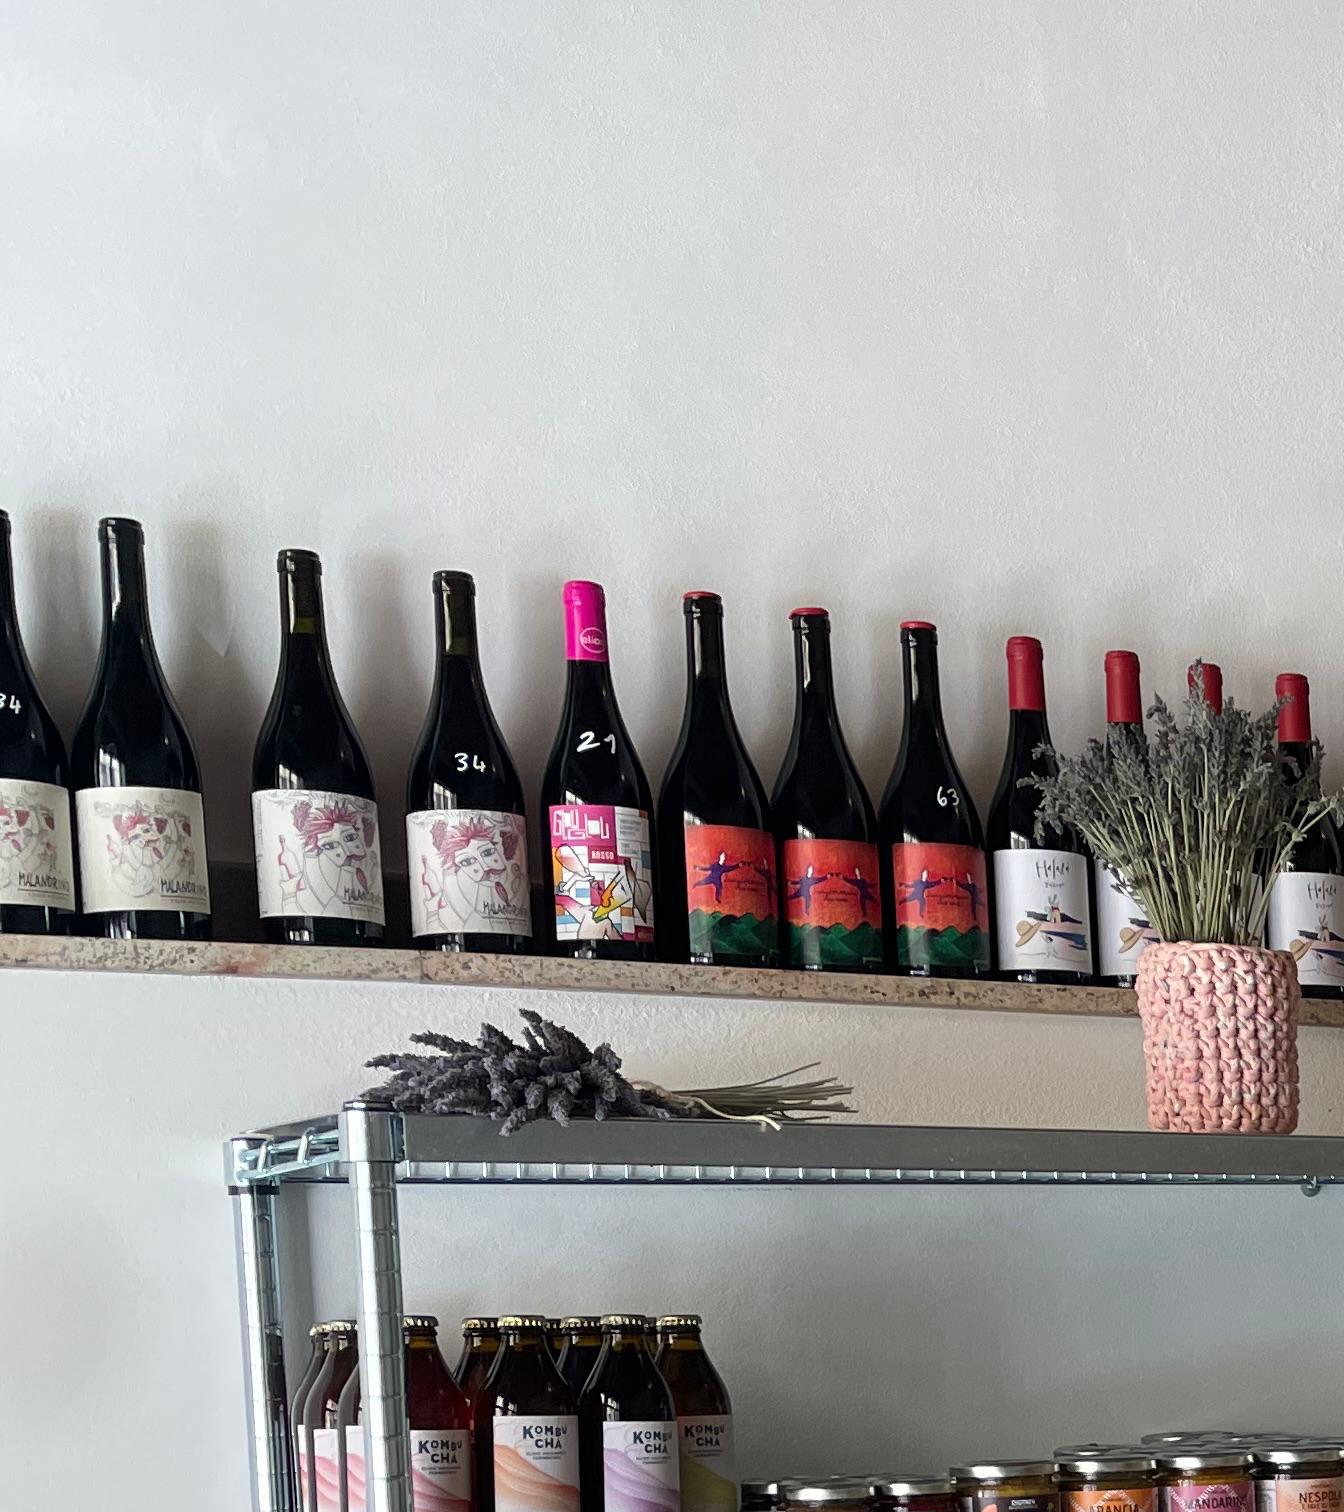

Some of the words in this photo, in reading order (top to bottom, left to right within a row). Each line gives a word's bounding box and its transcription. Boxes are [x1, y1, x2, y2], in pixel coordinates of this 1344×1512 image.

[576, 730, 616, 754] 21
[454, 752, 486, 772] 34
[937, 786, 959, 807] 63
[523, 1424, 568, 1440] KOMBU
[633, 1430, 672, 1446] KOMBU
[684, 1424, 726, 1439] KOMBU
[418, 1439, 463, 1455] KOMBU
[535, 1437, 562, 1450] CHA
[644, 1442, 668, 1455] CHA
[696, 1435, 720, 1448] CHA
[431, 1453, 458, 1466] CHA
